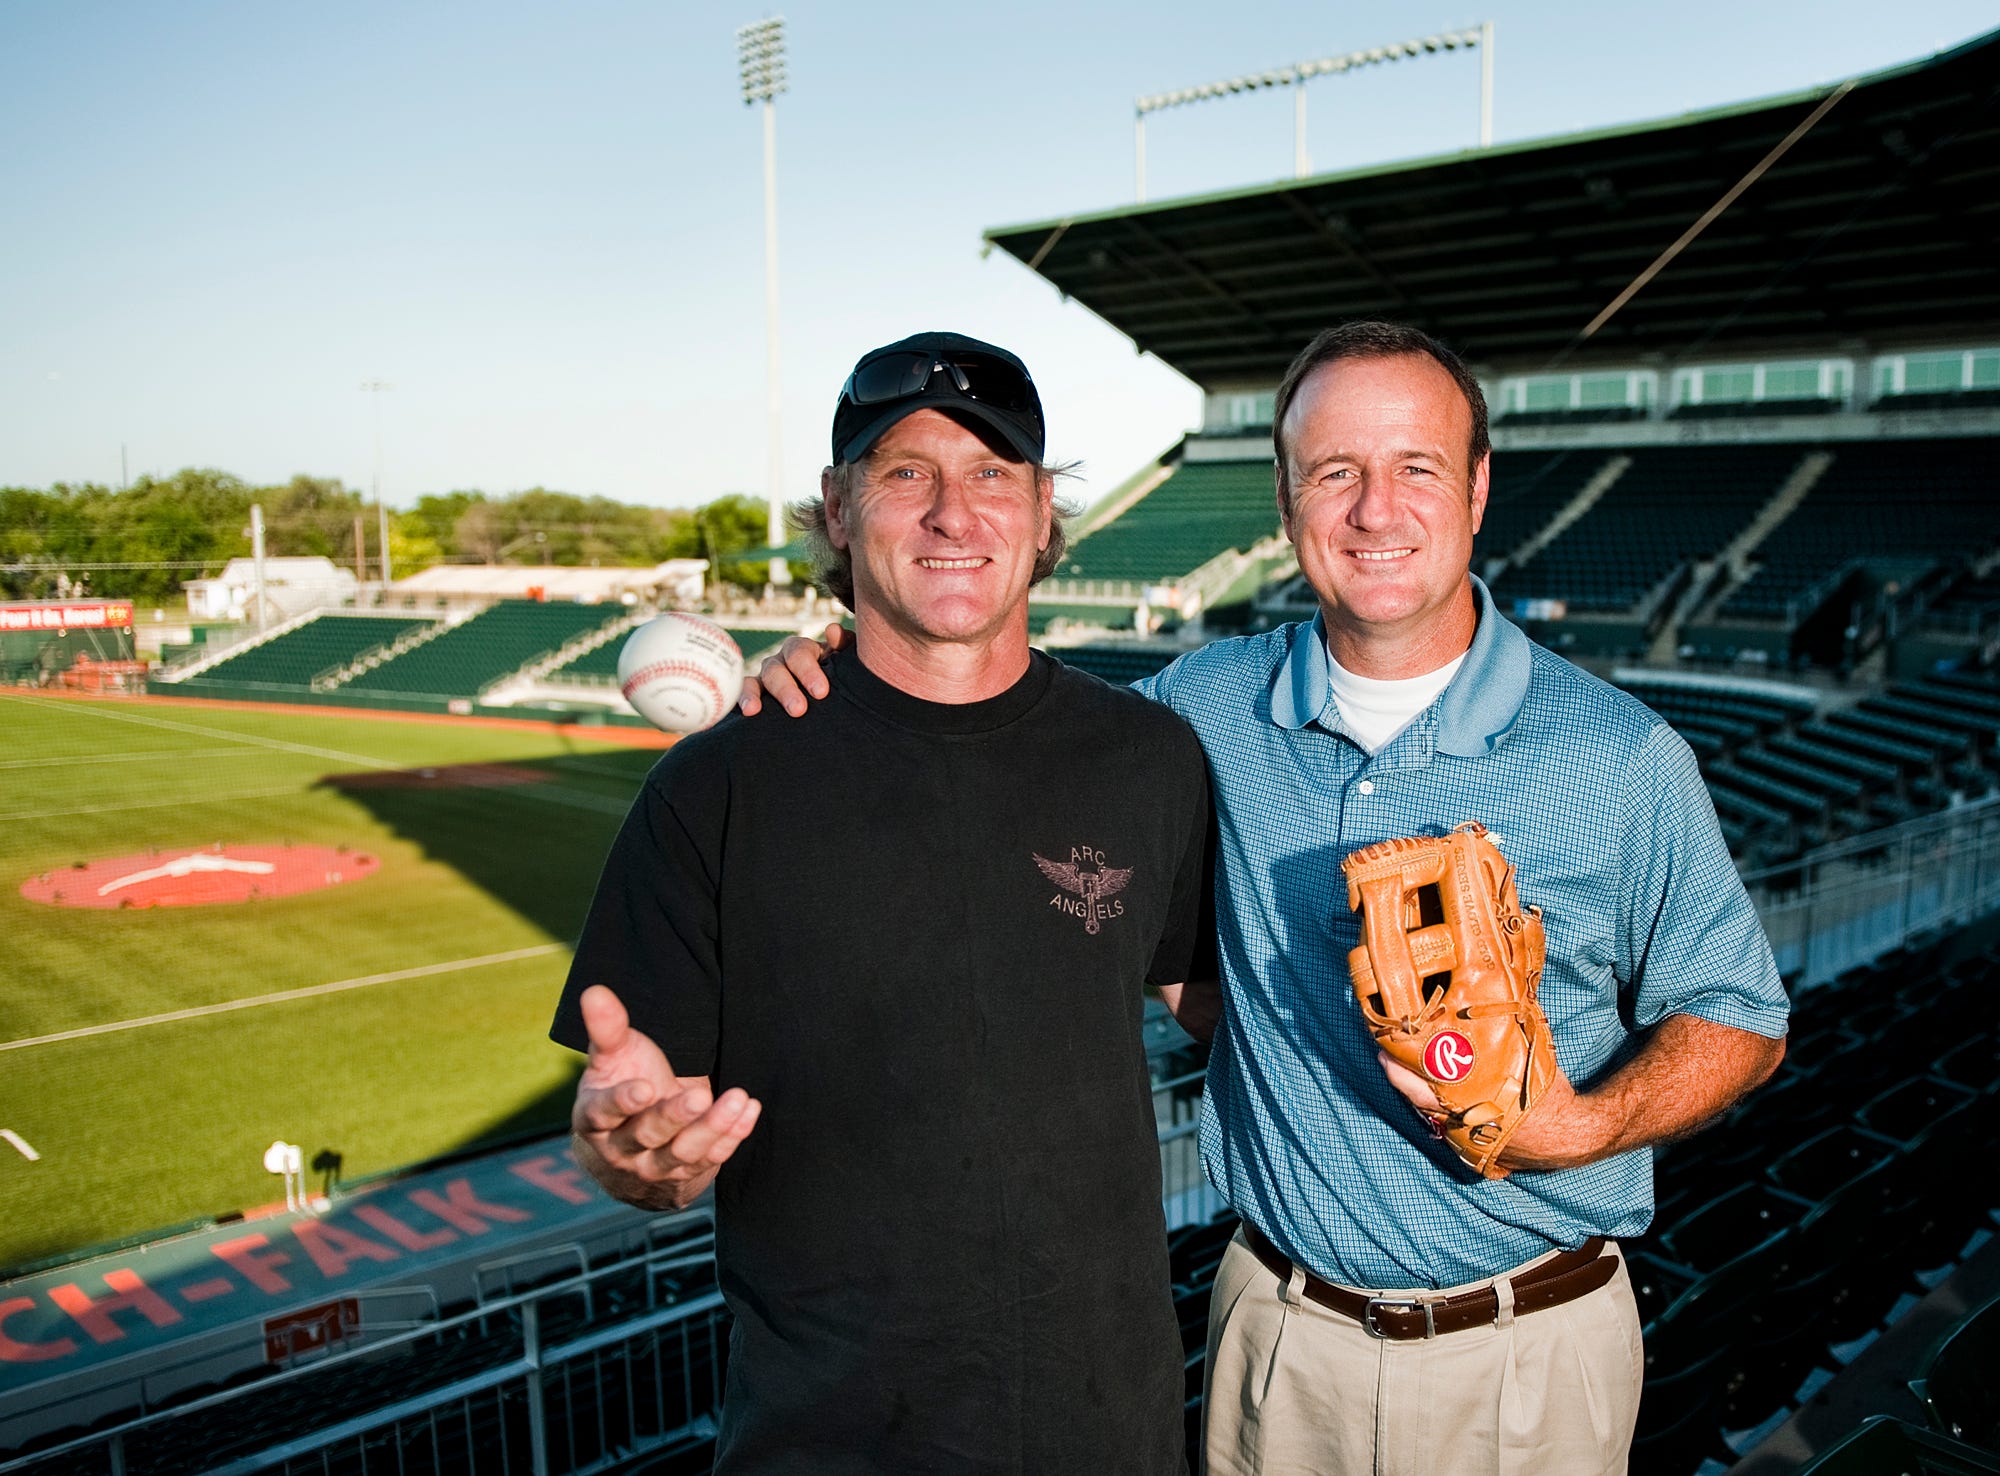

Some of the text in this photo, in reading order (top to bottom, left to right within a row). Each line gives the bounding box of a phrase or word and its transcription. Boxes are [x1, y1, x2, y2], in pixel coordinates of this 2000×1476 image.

[1071, 846, 1105, 866] ARC
[1454, 846, 1470, 893] SERIES
[1049, 893, 1124, 919] ANGELS
[1463, 894, 1482, 937] GLOVE
[1477, 938, 1495, 971] GOLD
[1435, 1035, 1473, 1080] R
